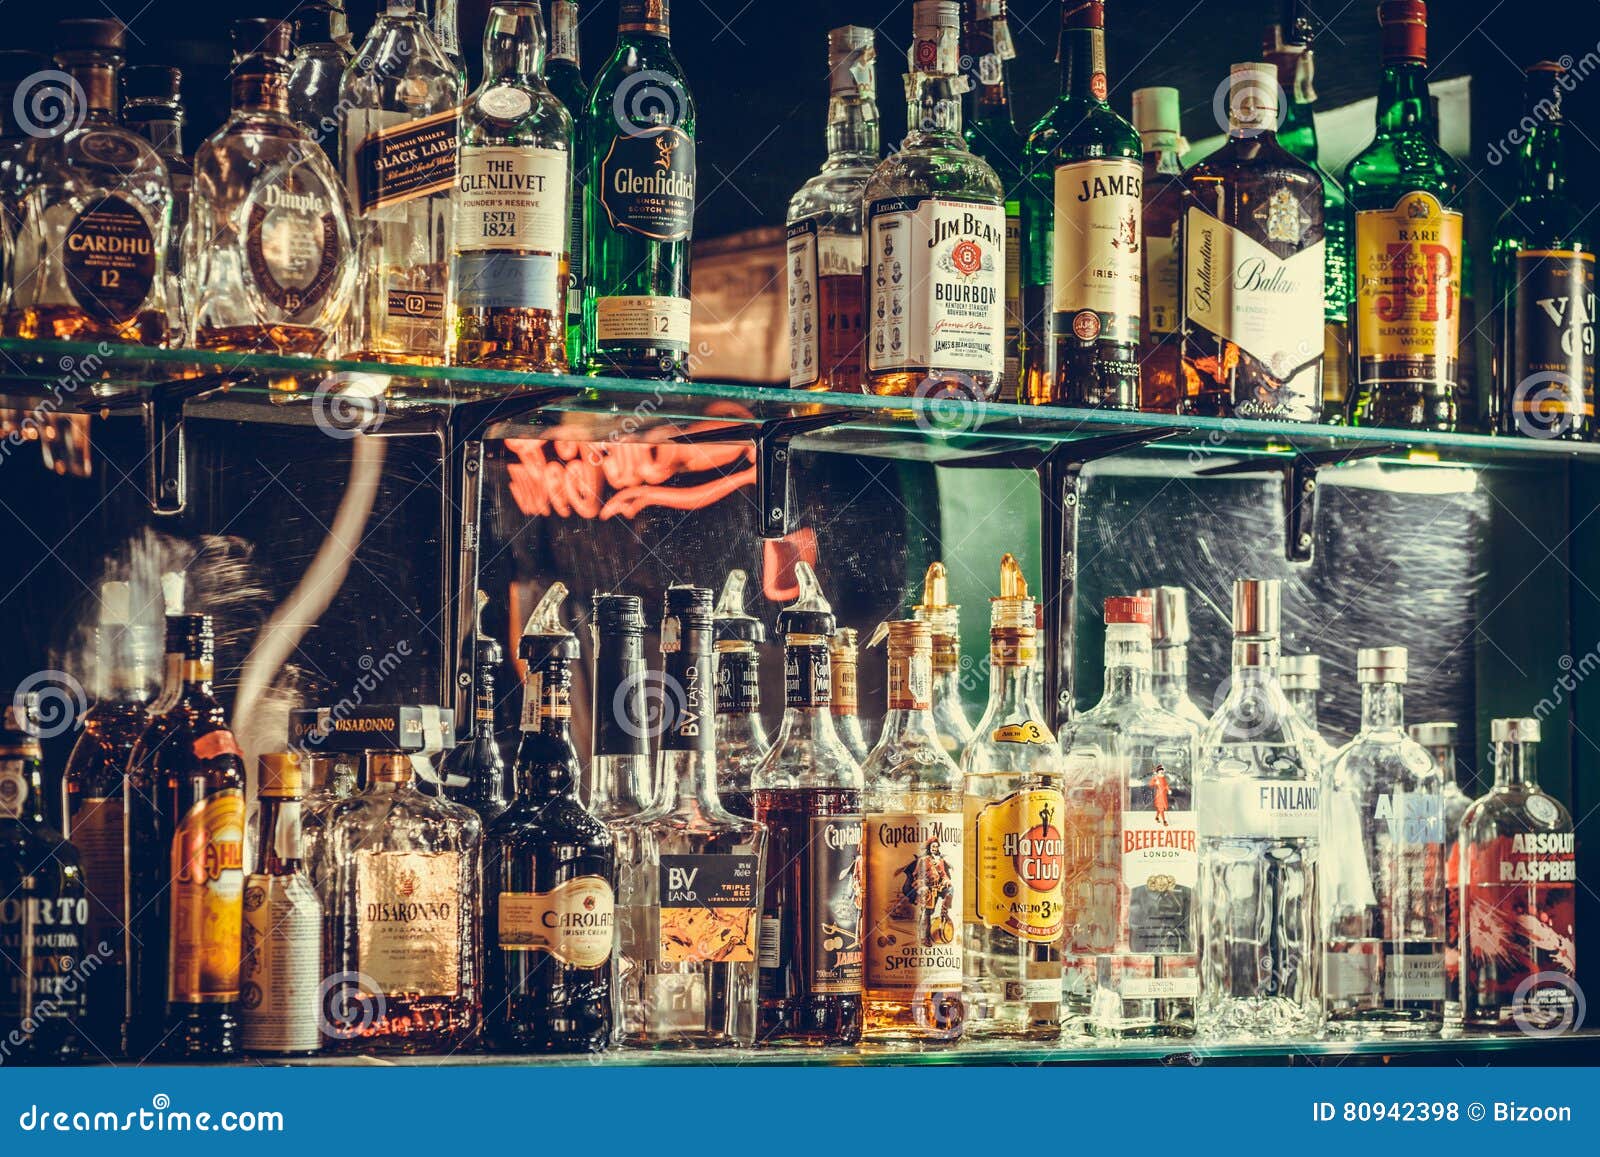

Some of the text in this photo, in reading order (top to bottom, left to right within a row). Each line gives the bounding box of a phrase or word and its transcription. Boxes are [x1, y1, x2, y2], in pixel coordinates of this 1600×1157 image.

[374, 149, 419, 171] BLACK
[486, 160, 513, 172] THE
[460, 174, 546, 193] GLENLIVET
[263, 184, 323, 215] Dimple
[463, 199, 541, 208] FOUNDER'S RESERVE
[482, 211, 516, 223] ESTD
[482, 222, 517, 237] 1824
[927, 212, 1001, 253] JIM BEAM
[1398, 229, 1439, 241] RARE
[68, 233, 151, 256] CARDHU
[101, 269, 120, 288] 12
[285, 293, 301, 309] 15
[935, 282, 997, 305] BOURBON
[409, 297, 422, 311] 12
[653, 316, 669, 333] 12
[686, 666, 699, 707] LAND
[335, 717, 396, 733] DISARONNO
[680, 708, 700, 737] BV
[1029, 725, 1041, 739] 3
[878, 821, 928, 849] Captain
[1123, 829, 1197, 855] BEEFEATER
[668, 866, 699, 891] BV
[1022, 858, 1061, 881] Club
[668, 890, 698, 902] LAND
[721, 883, 752, 891] TRIPLE
[367, 902, 451, 923] DISARONNO
[1041, 900, 1052, 919] 3
[562, 929, 586, 937] IRISH
[902, 947, 954, 956] ORIGINAL
[885, 955, 961, 971] SPICED GOLD
